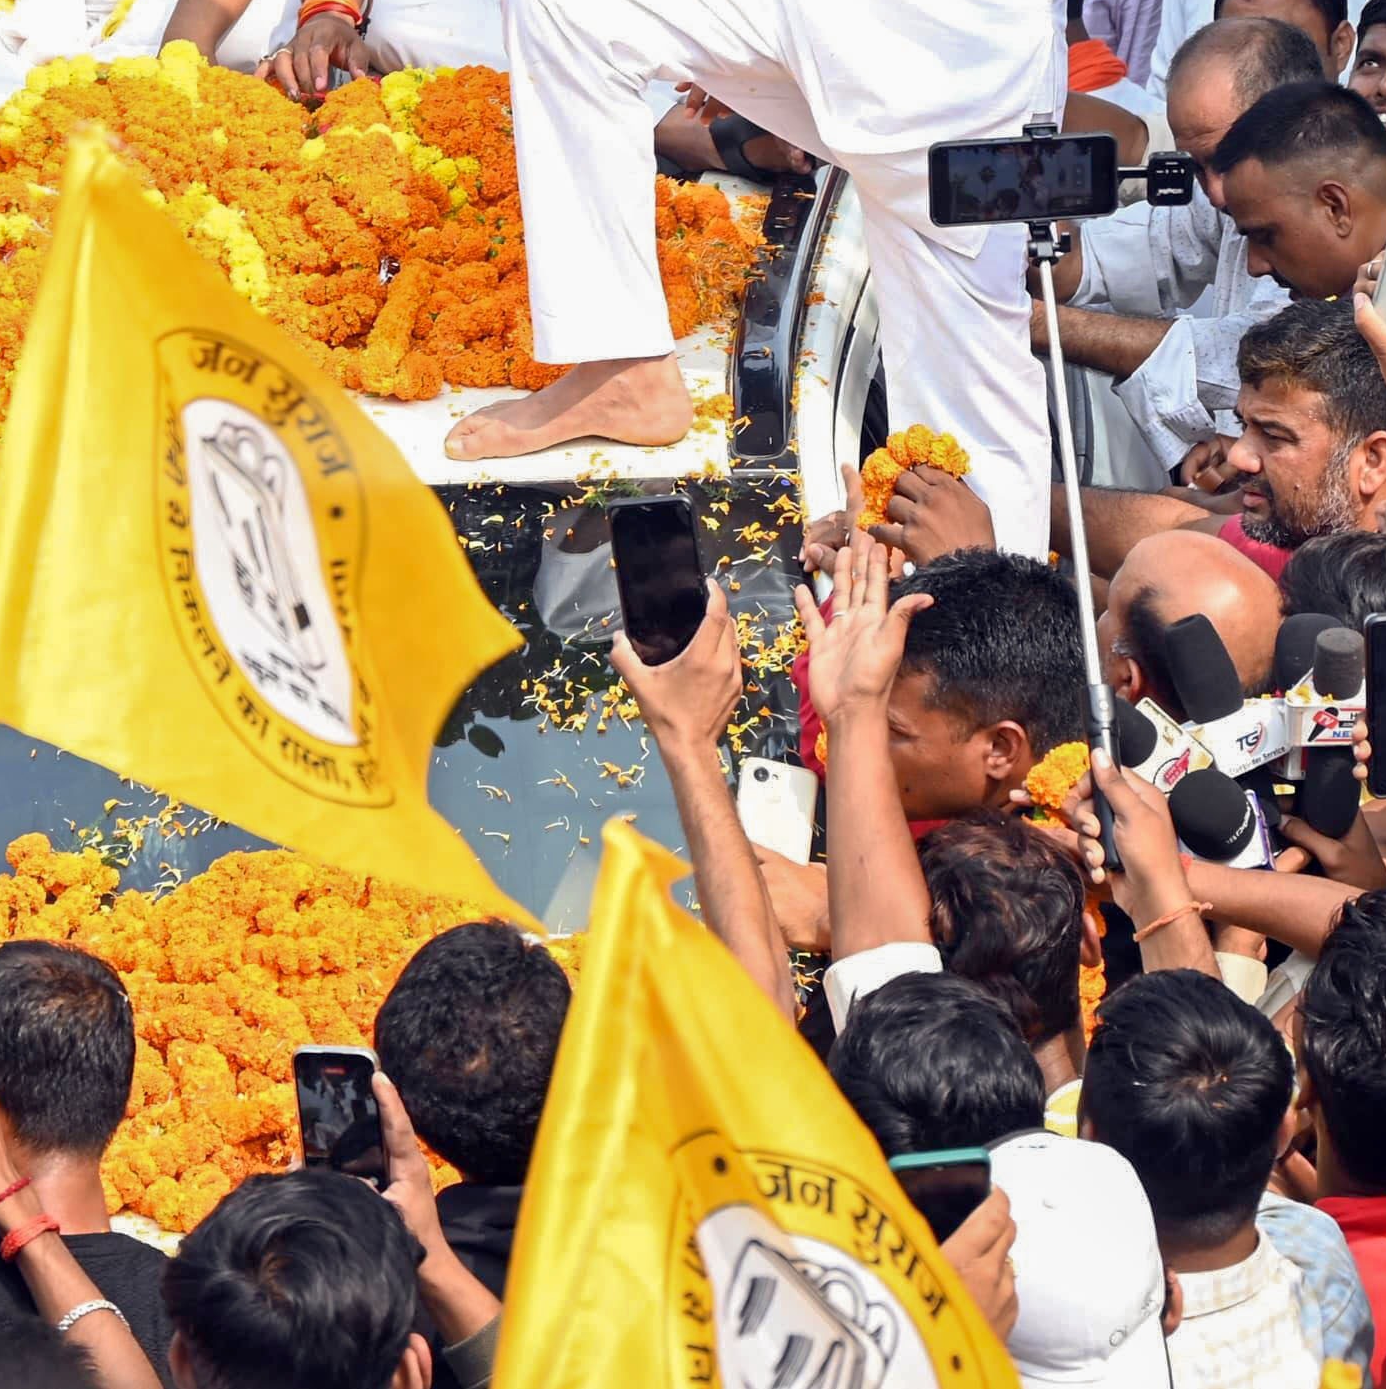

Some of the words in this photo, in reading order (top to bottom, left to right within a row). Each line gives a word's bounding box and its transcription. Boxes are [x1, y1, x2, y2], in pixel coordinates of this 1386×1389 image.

[192, 339, 262, 385] जन
[261, 372, 351, 478] सुराज
[756, 1157, 838, 1214] जन
[850, 1190, 949, 1320] सुराज
